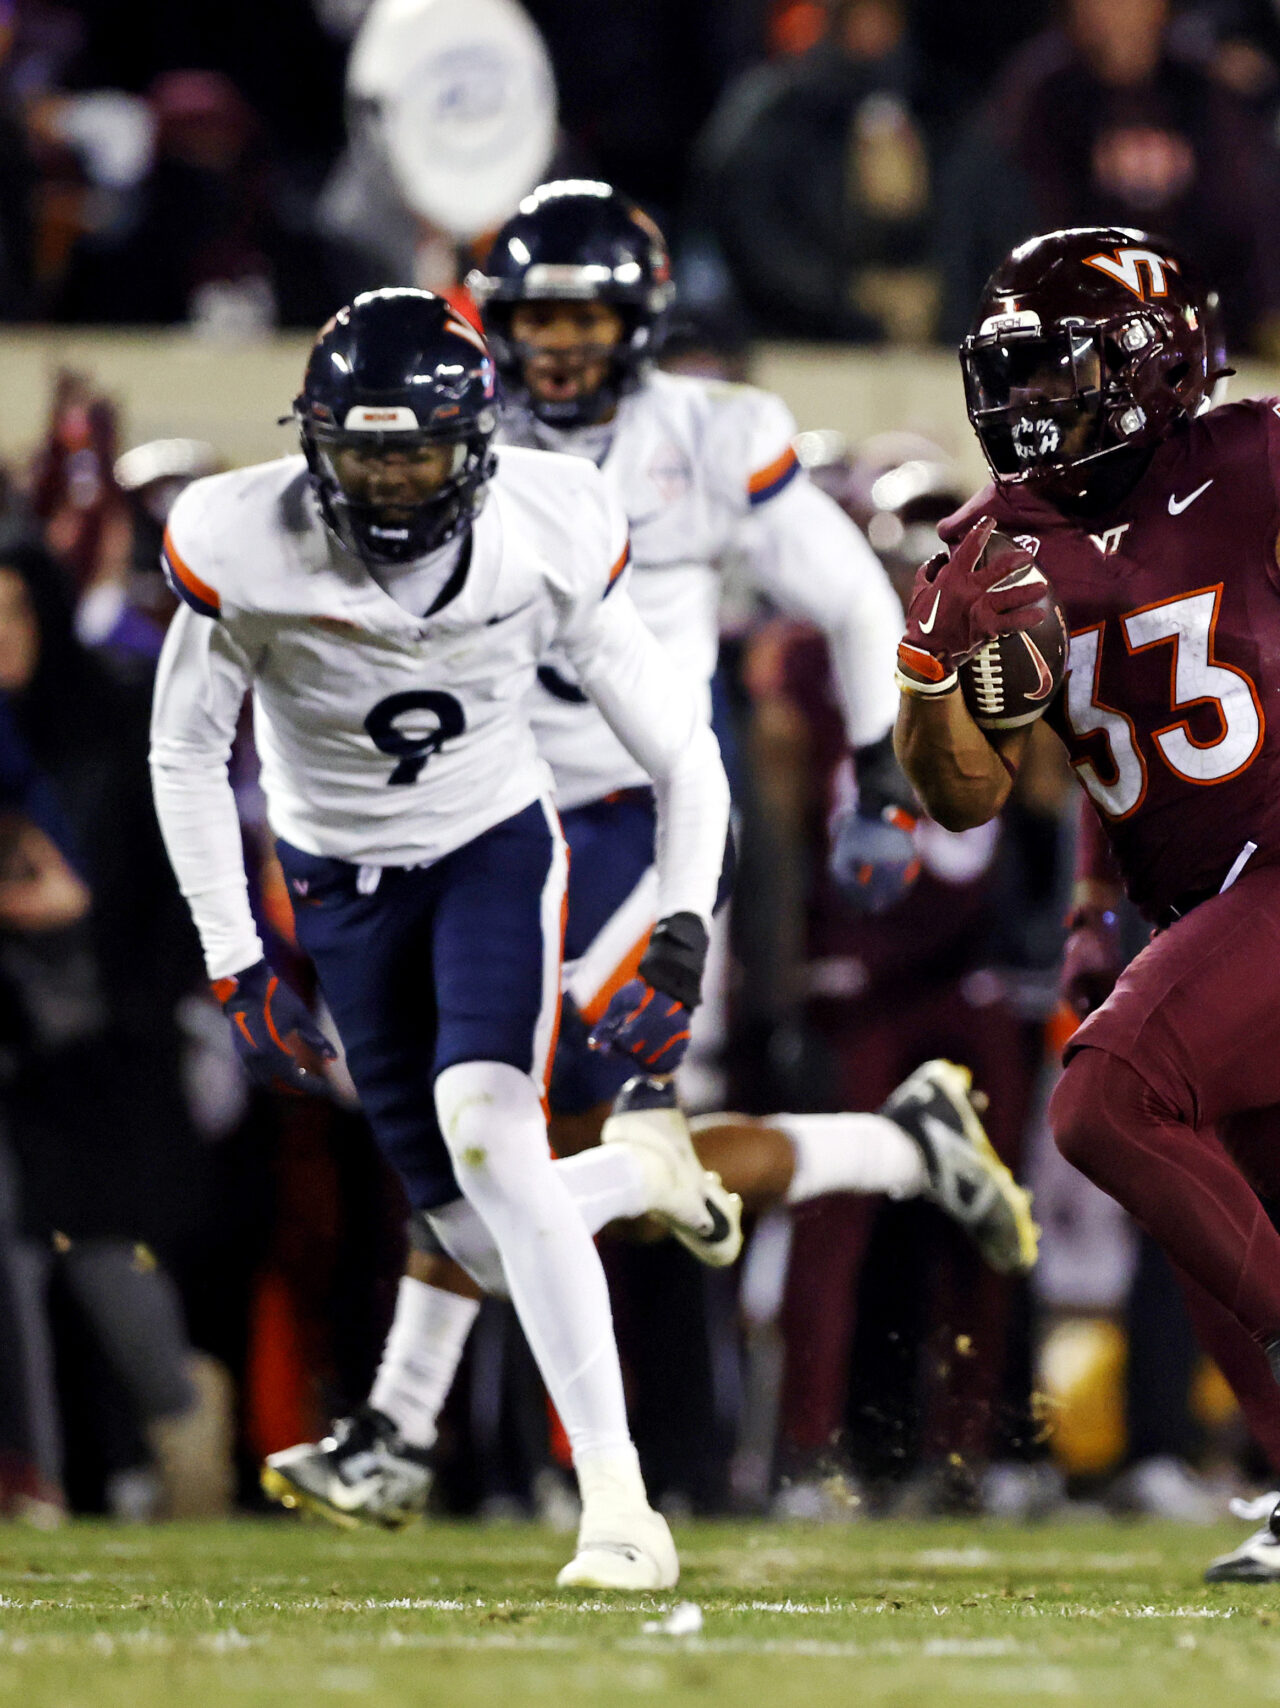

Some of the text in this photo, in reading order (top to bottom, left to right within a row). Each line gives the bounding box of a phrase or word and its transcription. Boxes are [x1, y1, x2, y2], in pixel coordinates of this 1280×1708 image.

[1081, 247, 1181, 302] VT
[990, 317, 1021, 331] TECH
[1088, 522, 1130, 555] VT
[1063, 581, 1266, 822] 33
[363, 689, 466, 787] 9
